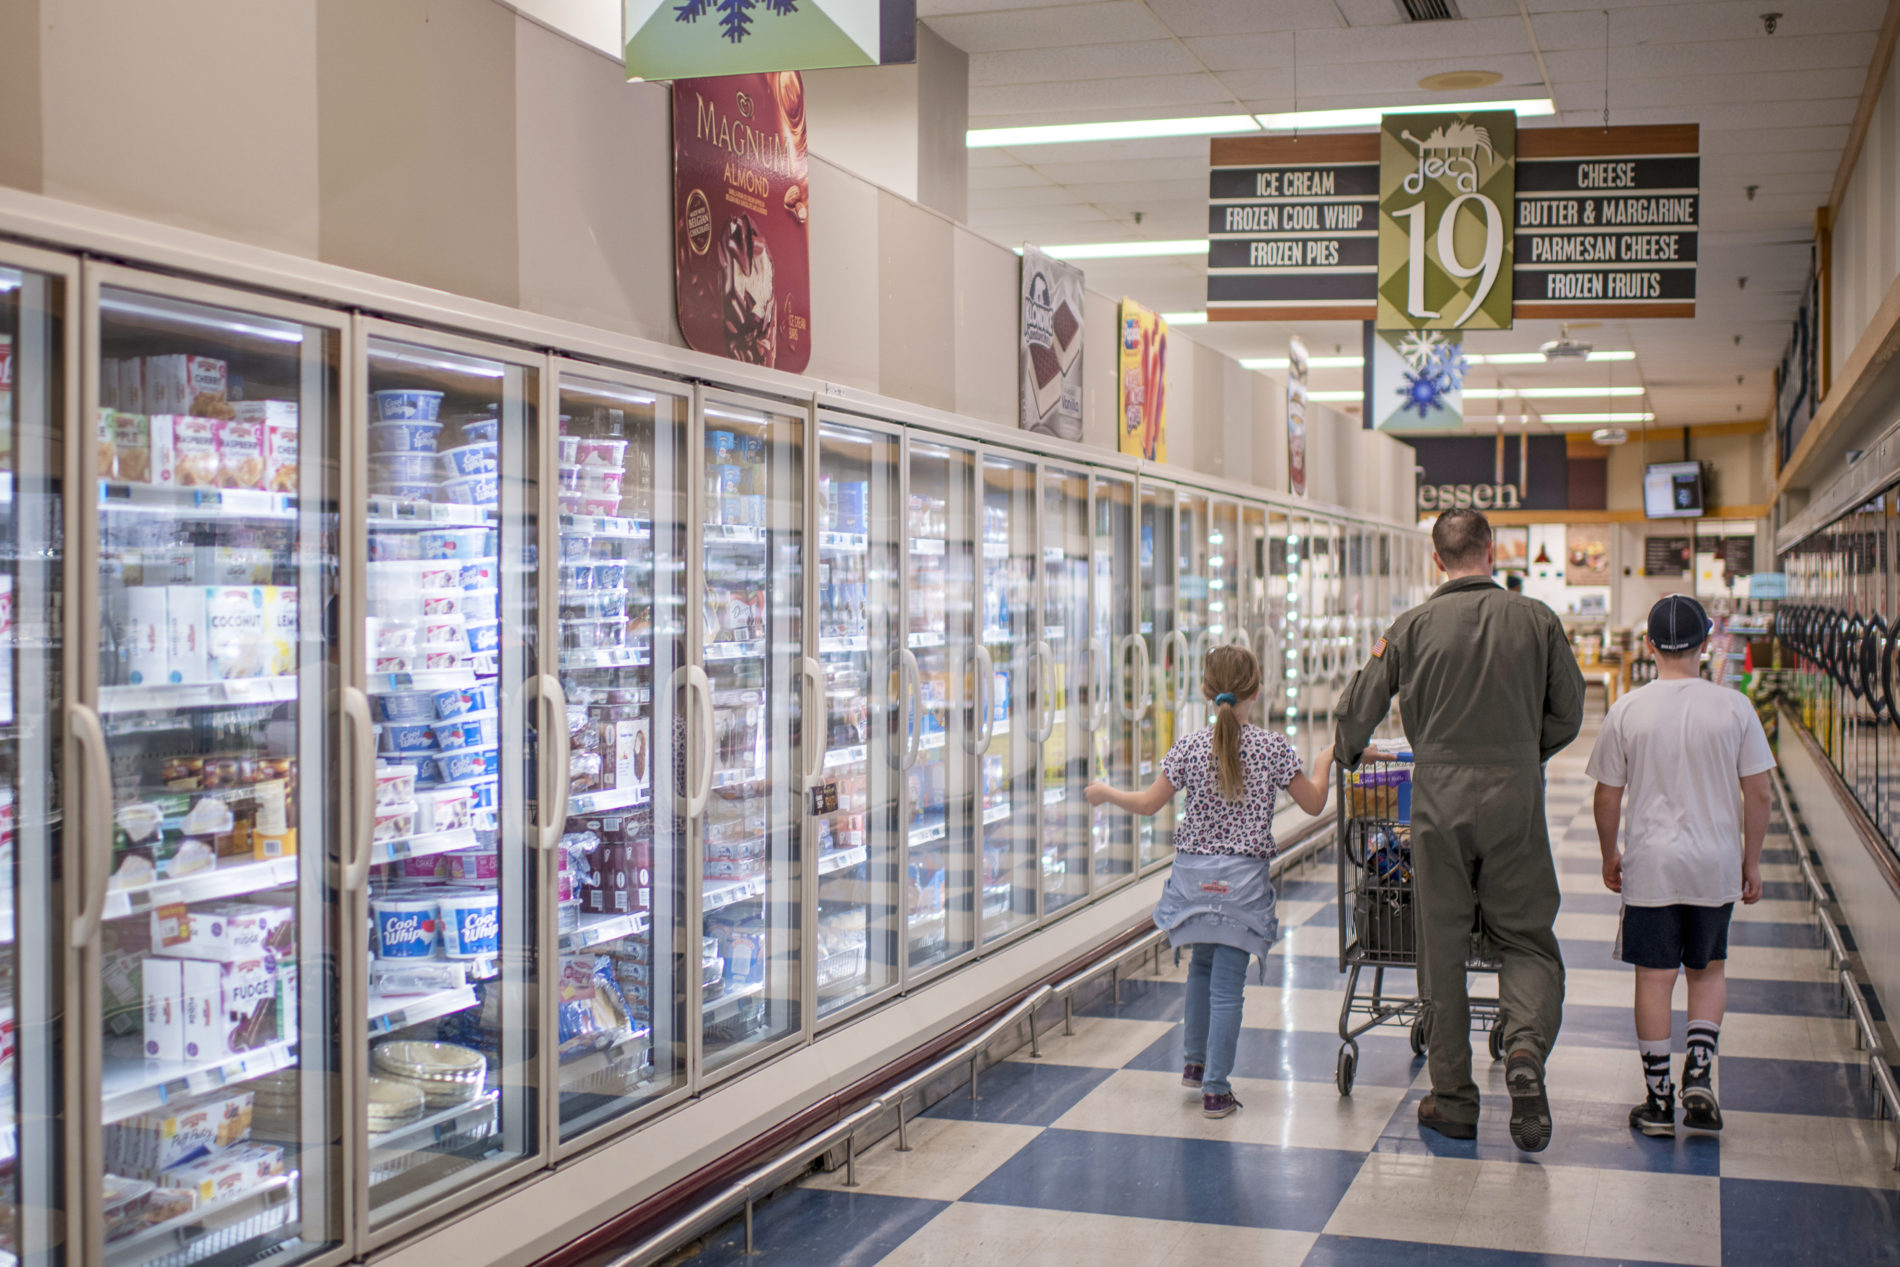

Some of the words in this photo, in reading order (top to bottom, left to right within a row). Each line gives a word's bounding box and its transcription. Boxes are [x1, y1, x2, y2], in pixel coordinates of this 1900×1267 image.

[695, 91, 792, 178] MAGNUM
[723, 161, 769, 198] ALMOND
[1256, 172, 1280, 196] ICE
[1283, 170, 1335, 196] CREAM
[1578, 162, 1636, 188] CHEESE
[688, 213, 709, 229] BELGIAN
[1225, 206, 1279, 231] FROZEN
[1283, 204, 1320, 230] COOL
[1323, 204, 1363, 229] WHIP
[1520, 200, 1578, 226] BUTTER
[1583, 199, 1596, 225] &
[1602, 198, 1694, 225] MARGARINE
[1250, 241, 1303, 267] FROZEN
[1306, 240, 1339, 265] PIES
[1391, 192, 1504, 328] 19
[1531, 236, 1616, 262] PARMESAN
[1620, 234, 1679, 260] CHEESE
[1547, 272, 1602, 298] FROZEN
[1607, 272, 1661, 298] FRUITS
[1418, 483, 1521, 509] essen
[211, 614, 261, 628] COCONUT
[386, 915, 418, 932] Cool
[464, 909, 497, 927] Cool
[384, 927, 421, 946] Whip
[461, 923, 498, 944] Whip
[232, 980, 269, 1000] FUDGE
